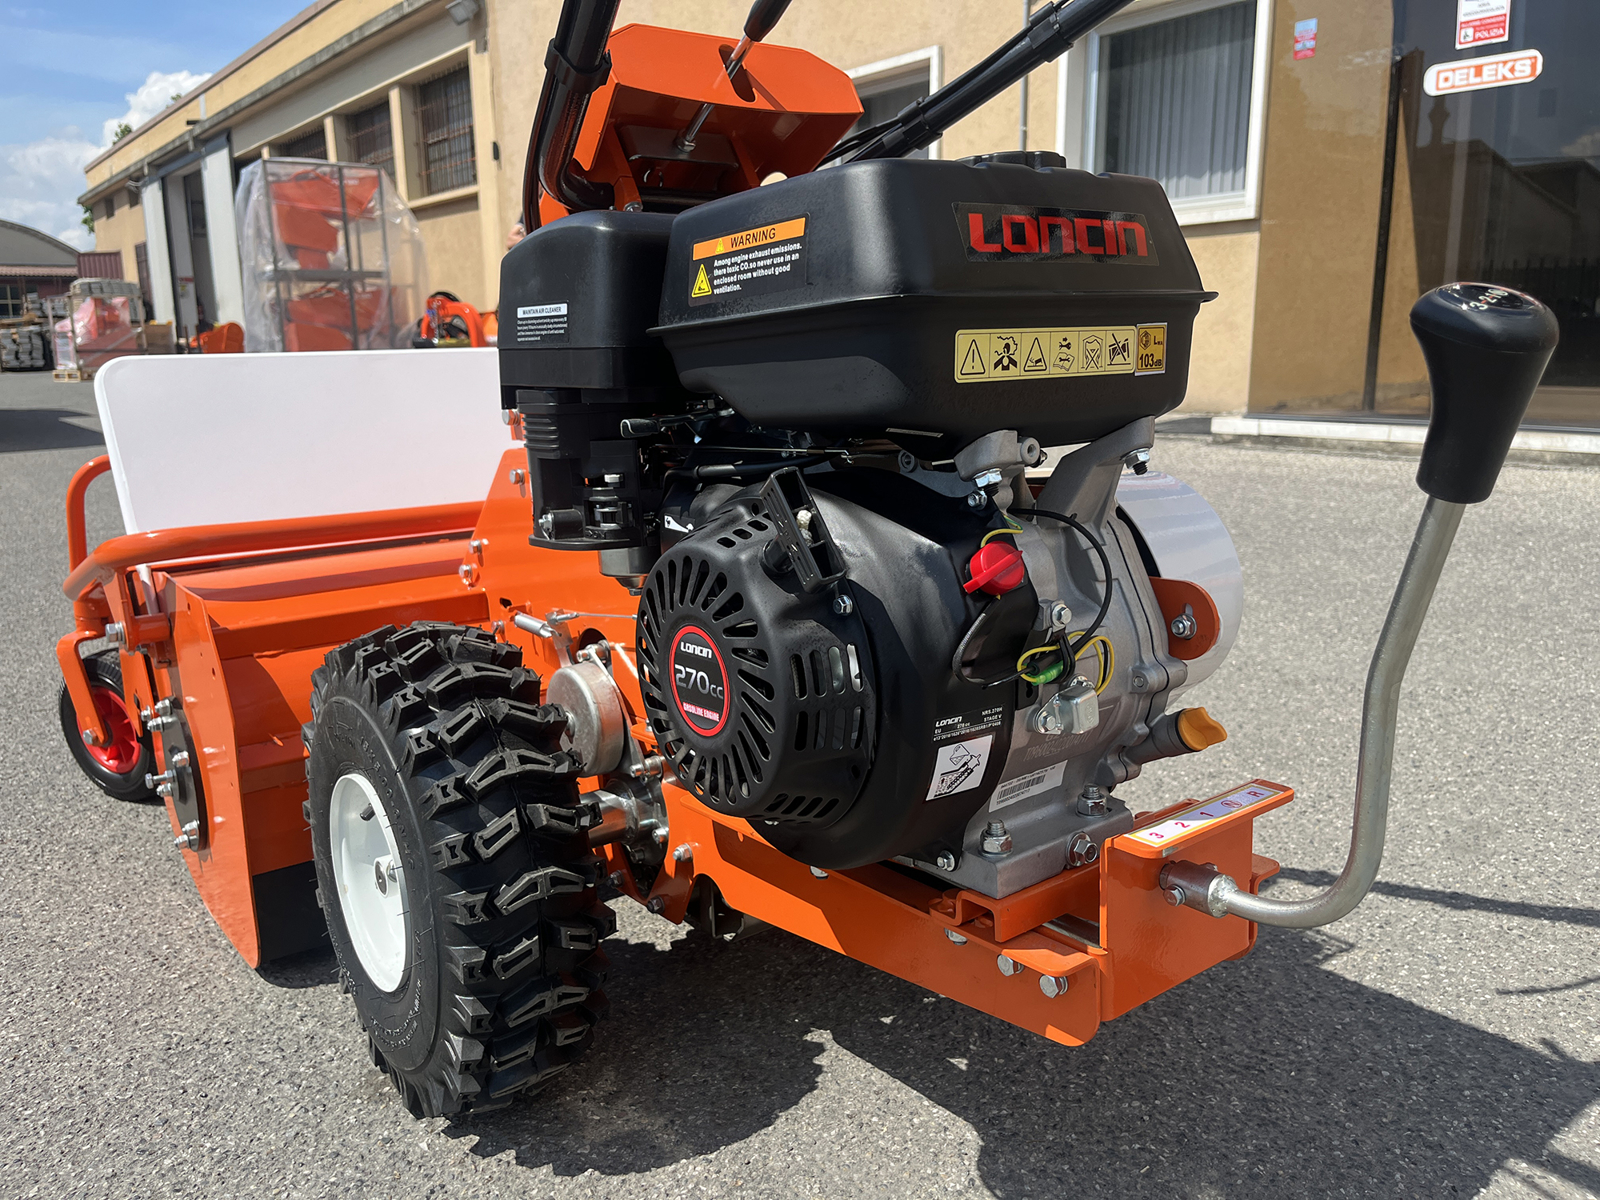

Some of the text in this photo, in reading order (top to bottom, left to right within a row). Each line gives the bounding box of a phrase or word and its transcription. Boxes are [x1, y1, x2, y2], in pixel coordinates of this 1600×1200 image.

[1475, 27, 1504, 39] POLIZIA
[1438, 59, 1532, 89] DELEKS
[730, 227, 776, 248] WARNING
[714, 258, 731, 268] Among
[731, 252, 748, 264] engine
[749, 247, 770, 259] exhaust
[728, 264, 740, 275] toxic
[757, 258, 773, 268] never
[773, 255, 784, 264] use
[784, 253, 791, 262] in
[791, 252, 800, 260] an
[713, 263, 791, 286] enclosed room without good
[545, 306, 562, 314] CLEANER
[1470, 301, 1488, 310] 3
[683, 701, 720, 722] GASOLINE ENGINE
[1246, 790, 1265, 798] R
[1174, 821, 1191, 829] 2
